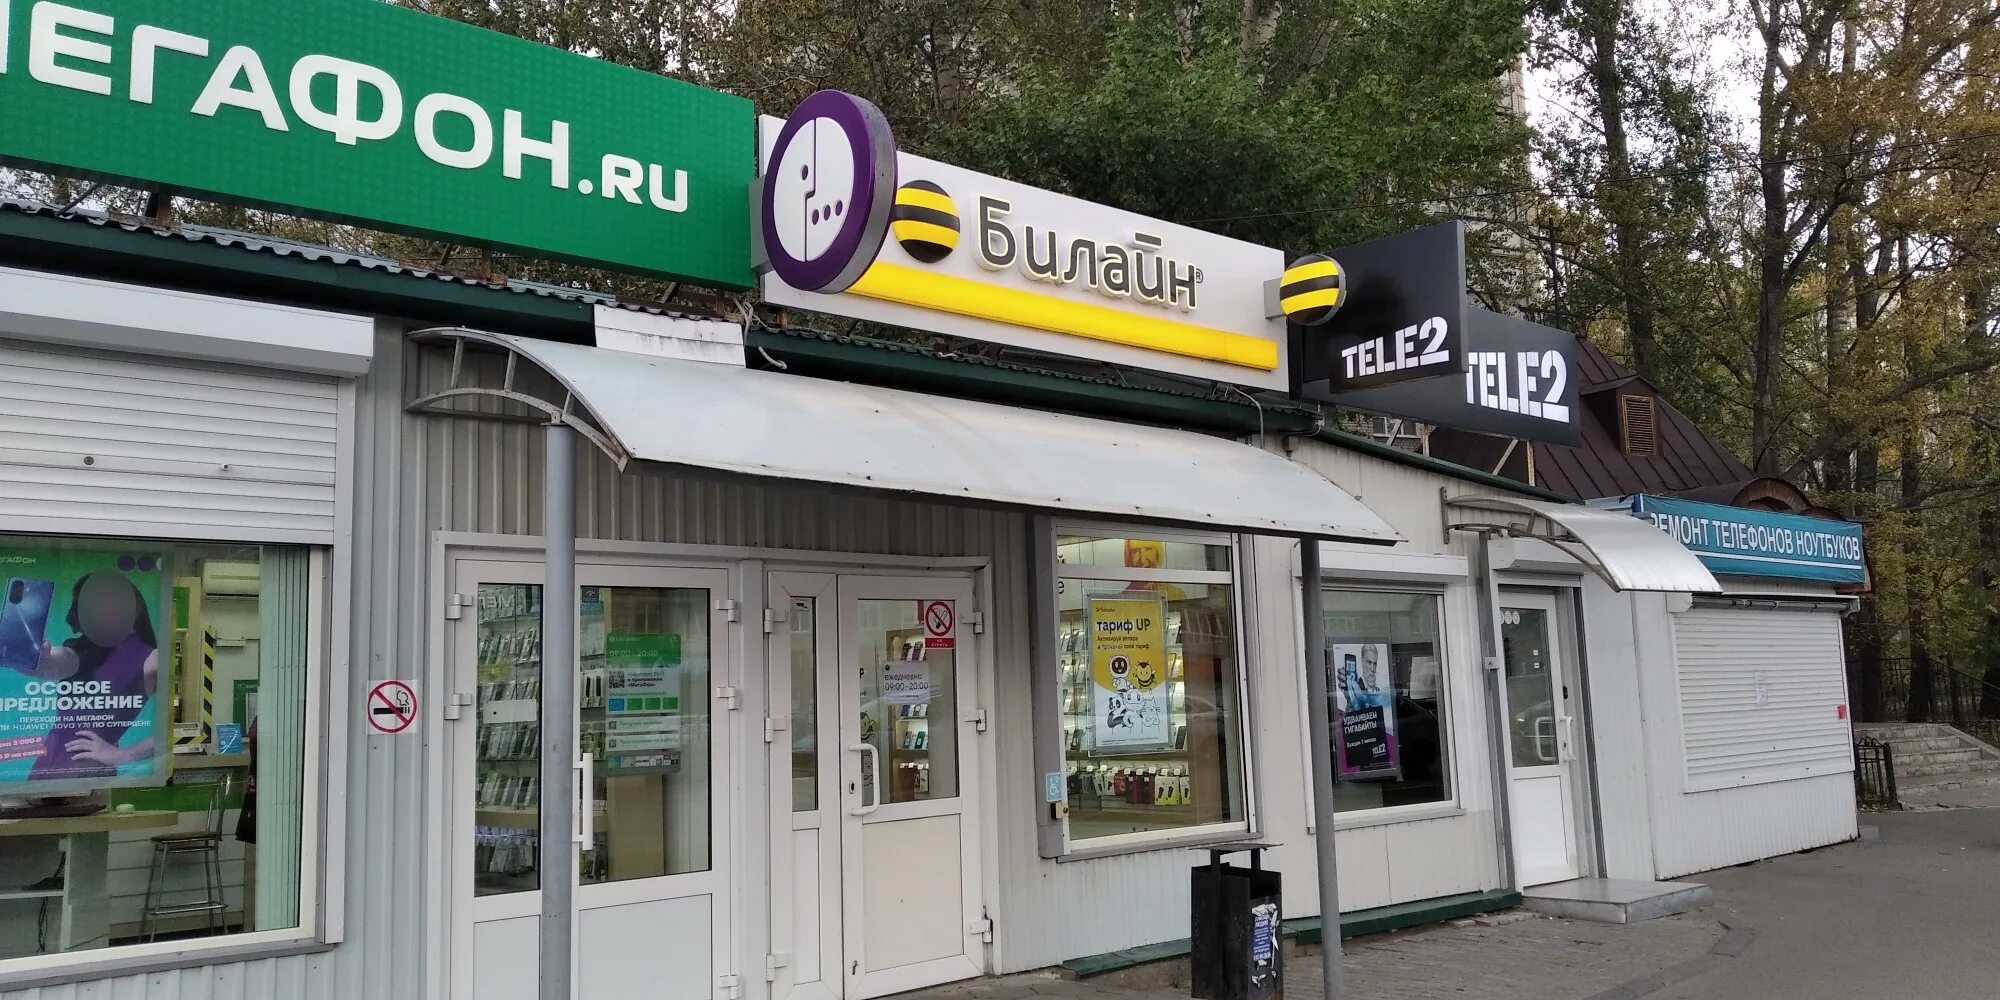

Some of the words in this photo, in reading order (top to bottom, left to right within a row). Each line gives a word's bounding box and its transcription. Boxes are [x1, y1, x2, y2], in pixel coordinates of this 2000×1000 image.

[0, 0, 689, 213] ЕГАФОН.RU
[1341, 316, 1449, 379] TELE2
[1712, 520, 1793, 554] ТЕЛЕФОНОВ
[1796, 532, 1861, 561] НОУТБУКОВ
[1096, 618, 1134, 635] тариф
[1136, 618, 1151, 631] UP
[24, 680, 111, 696] ОСОБОЕ
[0, 695, 143, 713] РЕДЛОЖЕНИЕ
[12, 723, 48, 731] HUAWEI
[77, 721, 91, 729] Y70
[106, 720, 151, 728] СУПЕРЦЕНЕ
[19, 715, 61, 723] ПЕРЕХОДИ
[76, 714, 114, 722] МЕГАФОН
[1343, 711, 1378, 726] УДВАИВАЕМ
[1344, 720, 1378, 735] ГИГАБАЙТЫ
[1371, 743, 1387, 755] TELE2
